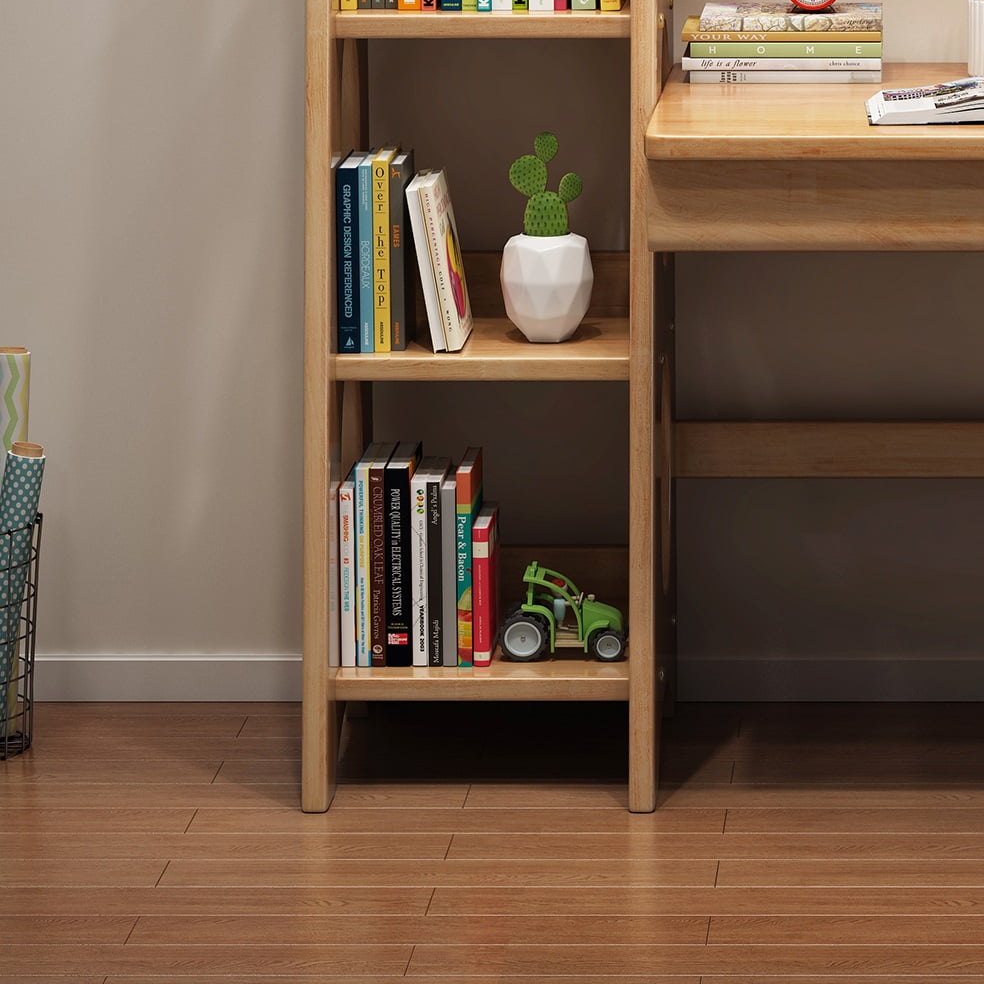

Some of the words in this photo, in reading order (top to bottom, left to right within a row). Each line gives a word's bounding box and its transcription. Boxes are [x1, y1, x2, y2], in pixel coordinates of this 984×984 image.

[700, 59, 715, 68] life
[716, 60, 723, 68] is
[732, 59, 758, 69] flower
[708, 46, 862, 54] HOME
[375, 166, 385, 211] Over
[342, 184, 352, 224] GRAPHIC
[343, 225, 352, 258] DESIGN
[360, 240, 370, 289] BORDEAUX
[344, 260, 353, 318] REFERENCED
[377, 268, 385, 307] Top
[371, 486, 383, 538] CRUMBLED
[390, 488, 402, 510] POWER
[389, 511, 402, 540] QUALITY
[457, 516, 467, 540] Pear
[372, 538, 383, 560] OAK
[458, 542, 466, 550] &
[373, 560, 384, 584] LEAF
[391, 546, 402, 586] ELECTRICAL
[458, 552, 467, 582] Bacon
[372, 589, 381, 615] Patricia
[391, 586, 402, 616] SYSTEMS
